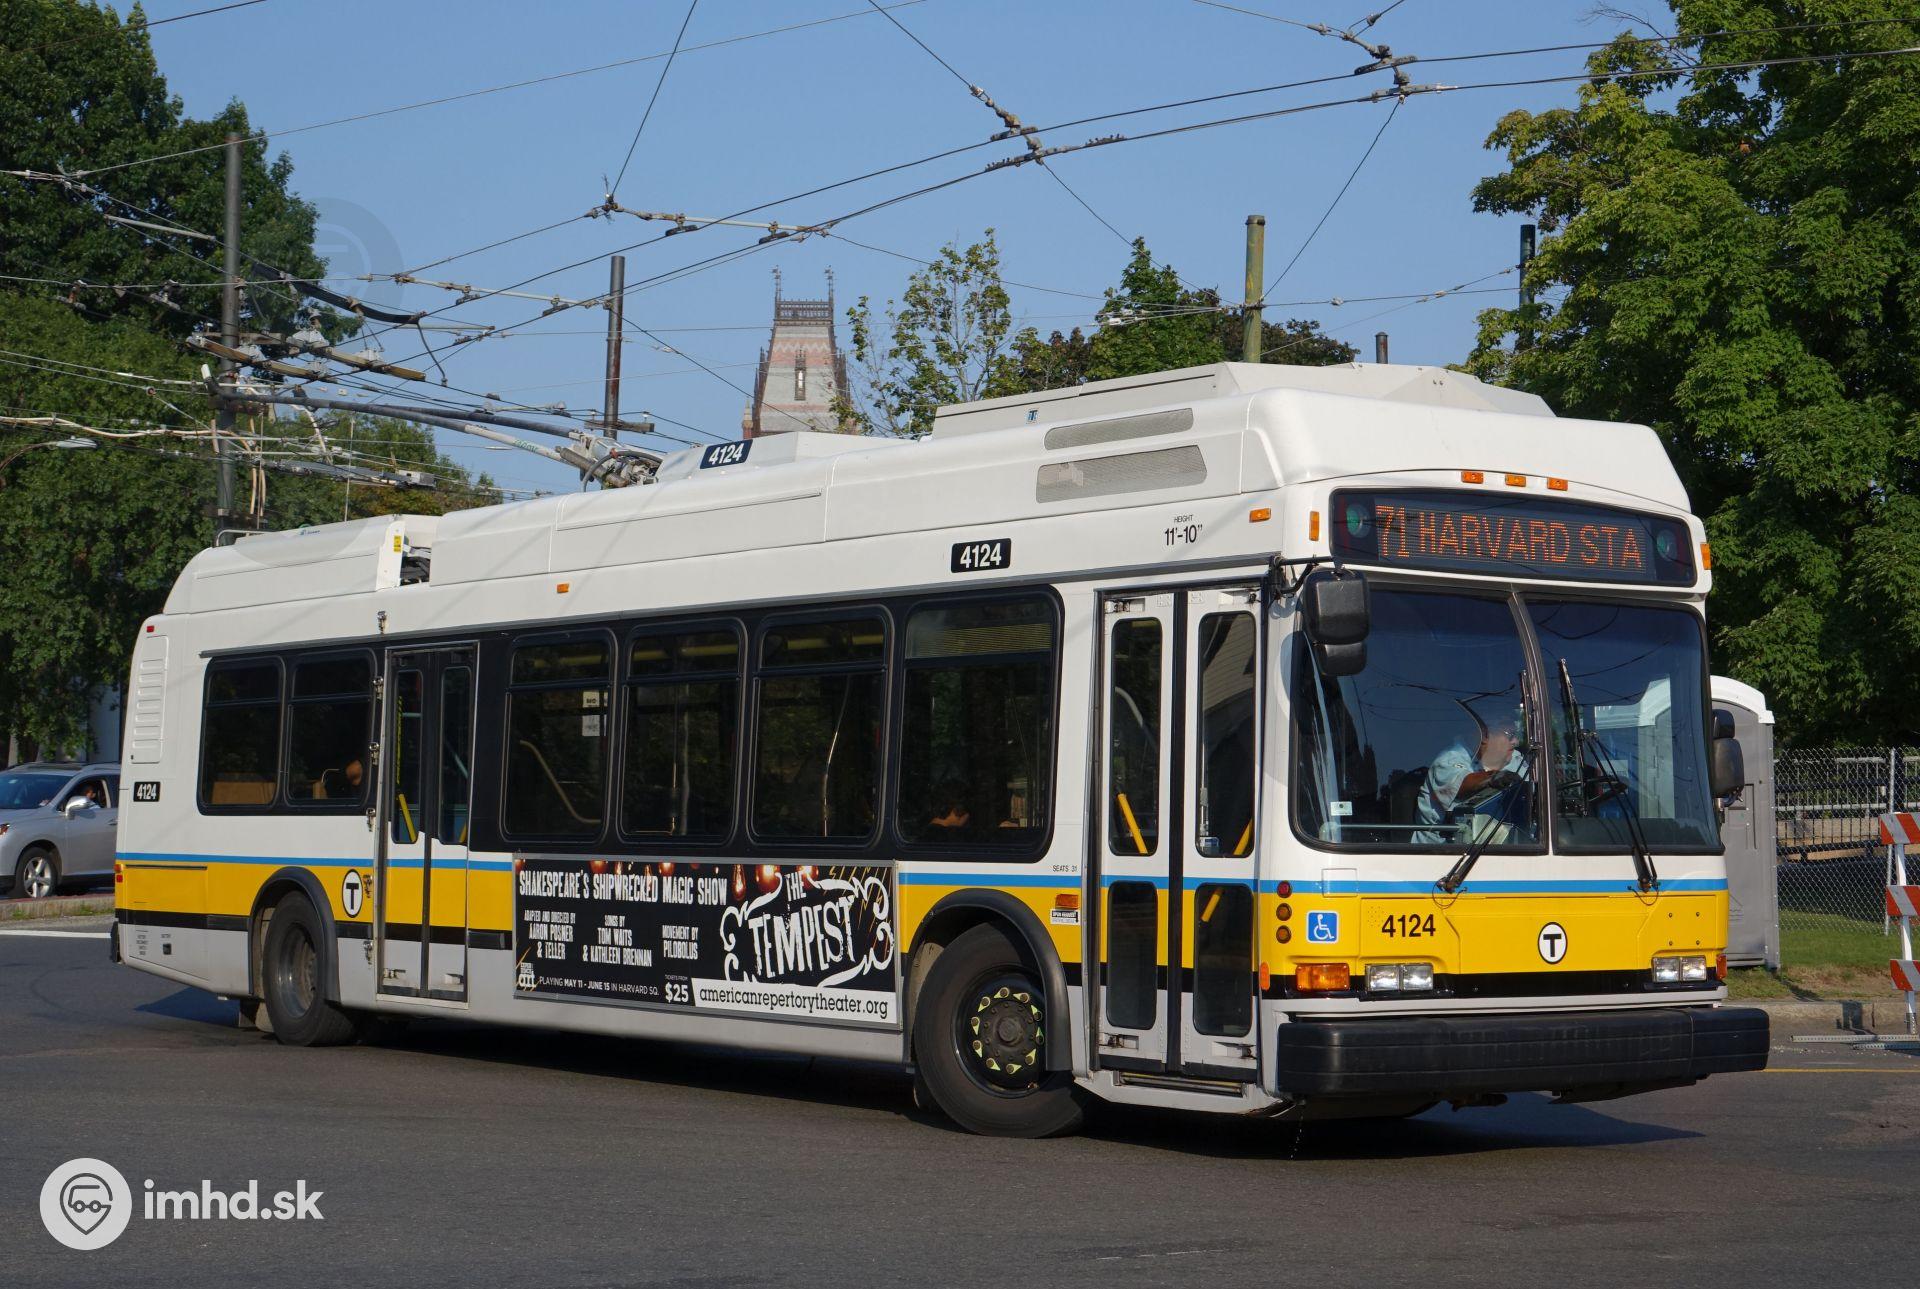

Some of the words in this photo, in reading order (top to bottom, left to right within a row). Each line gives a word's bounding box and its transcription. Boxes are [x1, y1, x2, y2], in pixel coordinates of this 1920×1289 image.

[708, 443, 745, 465] 4124
[1174, 514, 1194, 523] HEIGHT
[1376, 504, 1410, 558] 71
[1419, 511, 1570, 563] HARVARD
[1579, 524, 1642, 568] STA
[959, 542, 1002, 569] 4124
[136, 783, 157, 800] 4124
[1052, 864, 1070, 873] SEATS
[345, 882, 360, 910] T
[519, 869, 590, 900] SHAKESPEARE'S
[593, 873, 659, 903] SHIPWRECKED
[662, 875, 694, 905] MAGIC
[697, 877, 728, 906] SHOW
[785, 872, 807, 902] THE
[604, 914, 619, 927] SONGS
[619, 915, 626, 928] BY
[1381, 913, 1437, 938] 4124
[529, 923, 548, 940] AARON
[550, 924, 574, 942] POSNER
[597, 927, 611, 945] TOM
[613, 929, 633, 947] WAITS
[662, 925, 690, 940] MOVEMENT
[691, 926, 699, 940] BY
[748, 894, 855, 979] TEMPEST
[537, 941, 543, 958] &
[545, 941, 566, 960] TELLER
[582, 944, 589, 962] &
[590, 945, 620, 965] KATHLEEN
[622, 947, 653, 967] BRENNAN
[663, 940, 698, 960] PILOBOLUS
[1543, 933, 1562, 957] T
[539, 976, 563, 986] PLAYING
[564, 978, 577, 988] MAY
[577, 979, 583, 989] 11
[588, 980, 603, 991] JUNE
[603, 982, 610, 991] 15
[611, 982, 618, 991] IN
[618, 983, 648, 995] HARVARD
[649, 986, 660, 996] SQ.
[664, 981, 689, 1004] $25
[700, 986, 889, 1020] americanrepertorytheater.org
